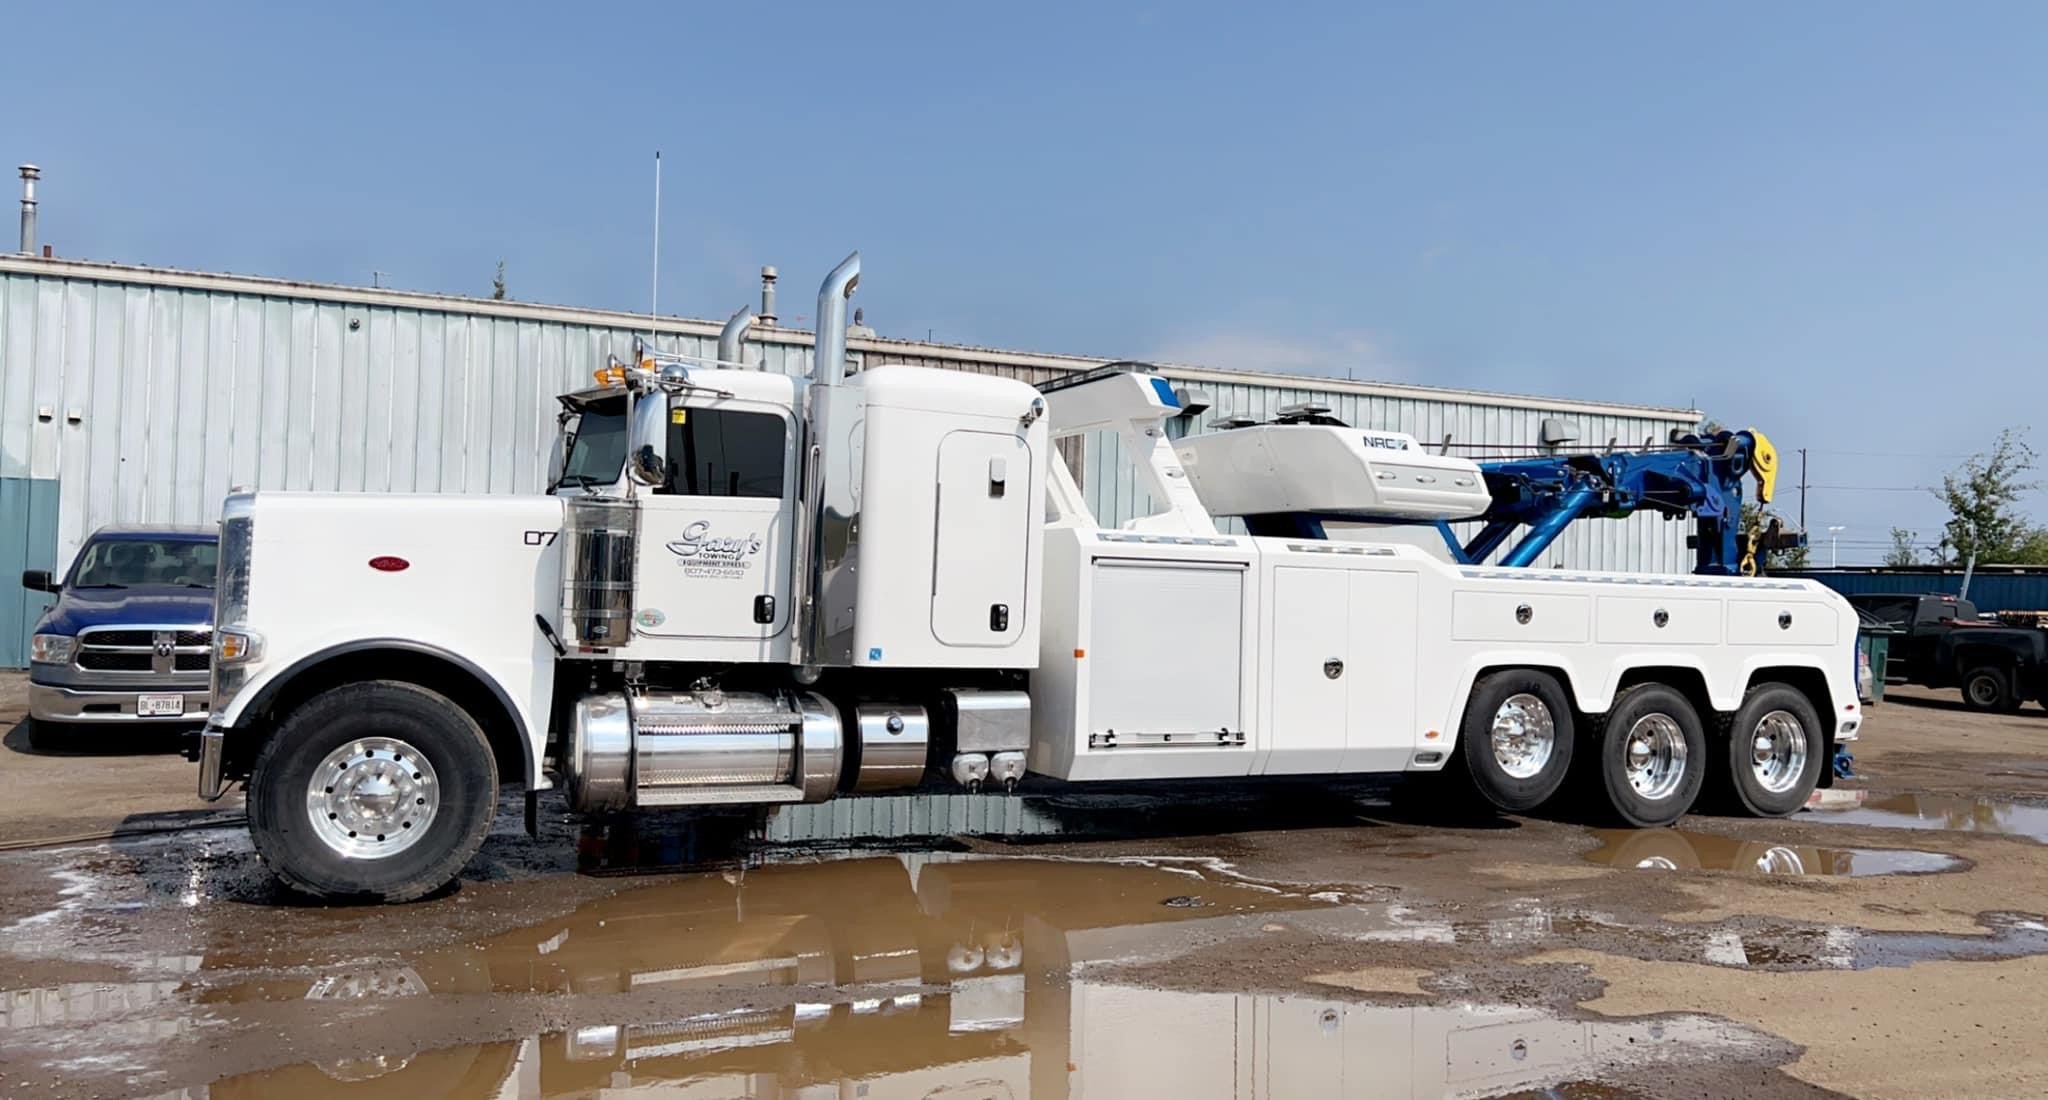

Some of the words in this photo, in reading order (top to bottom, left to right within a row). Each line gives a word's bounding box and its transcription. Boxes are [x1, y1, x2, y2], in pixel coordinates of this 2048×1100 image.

[1363, 435, 1397, 450] NRC
[524, 530, 559, 546] 07
[665, 520, 761, 561] Gary's
[683, 559, 721, 568] EQUIPMENT
